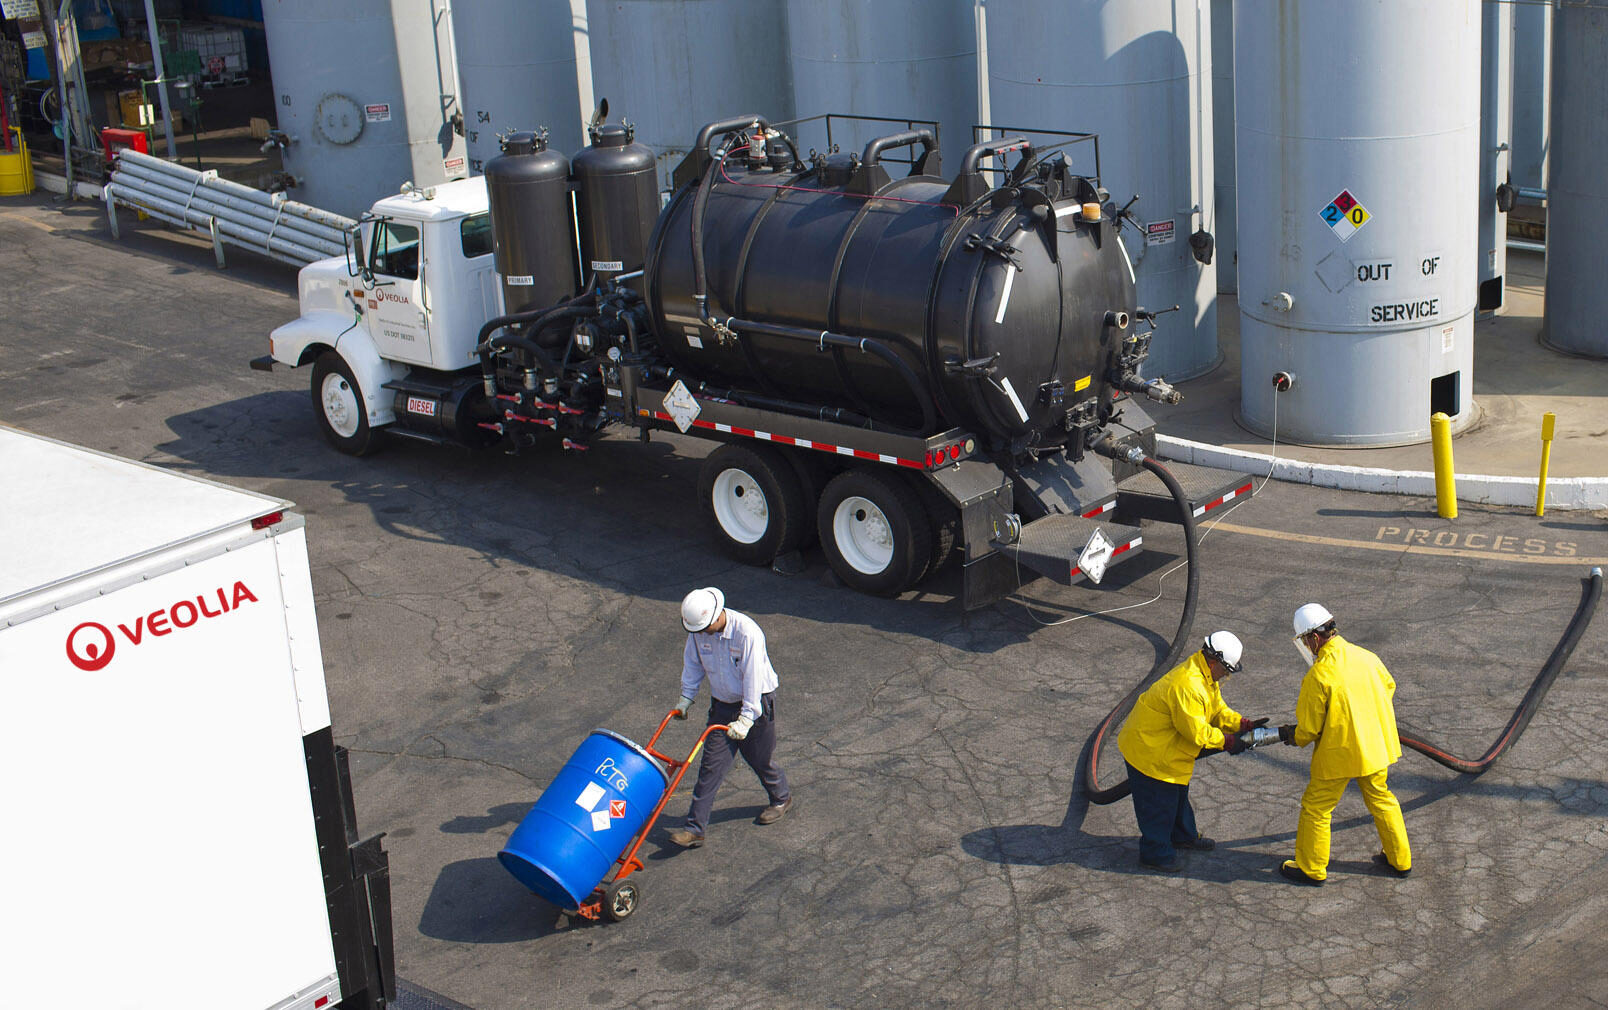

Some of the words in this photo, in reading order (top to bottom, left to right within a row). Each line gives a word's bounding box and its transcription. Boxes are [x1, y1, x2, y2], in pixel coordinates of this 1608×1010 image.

[477, 111, 490, 124] 54
[1340, 194, 1351, 210] 3
[1327, 206, 1337, 221] 2
[1352, 208, 1363, 224] 0
[1149, 222, 1173, 232] DANGER
[592, 262, 621, 270] SECONDARY
[1357, 264, 1393, 281] OUT
[1421, 257, 1441, 276] OF
[508, 276, 532, 284] PRIMARY
[384, 293, 409, 304] VEOLIA
[1371, 298, 1439, 322] SERVICE
[410, 399, 434, 414] DIESEL
[1376, 526, 1578, 556] PROCESS
[117, 581, 259, 645] VEOLIA
